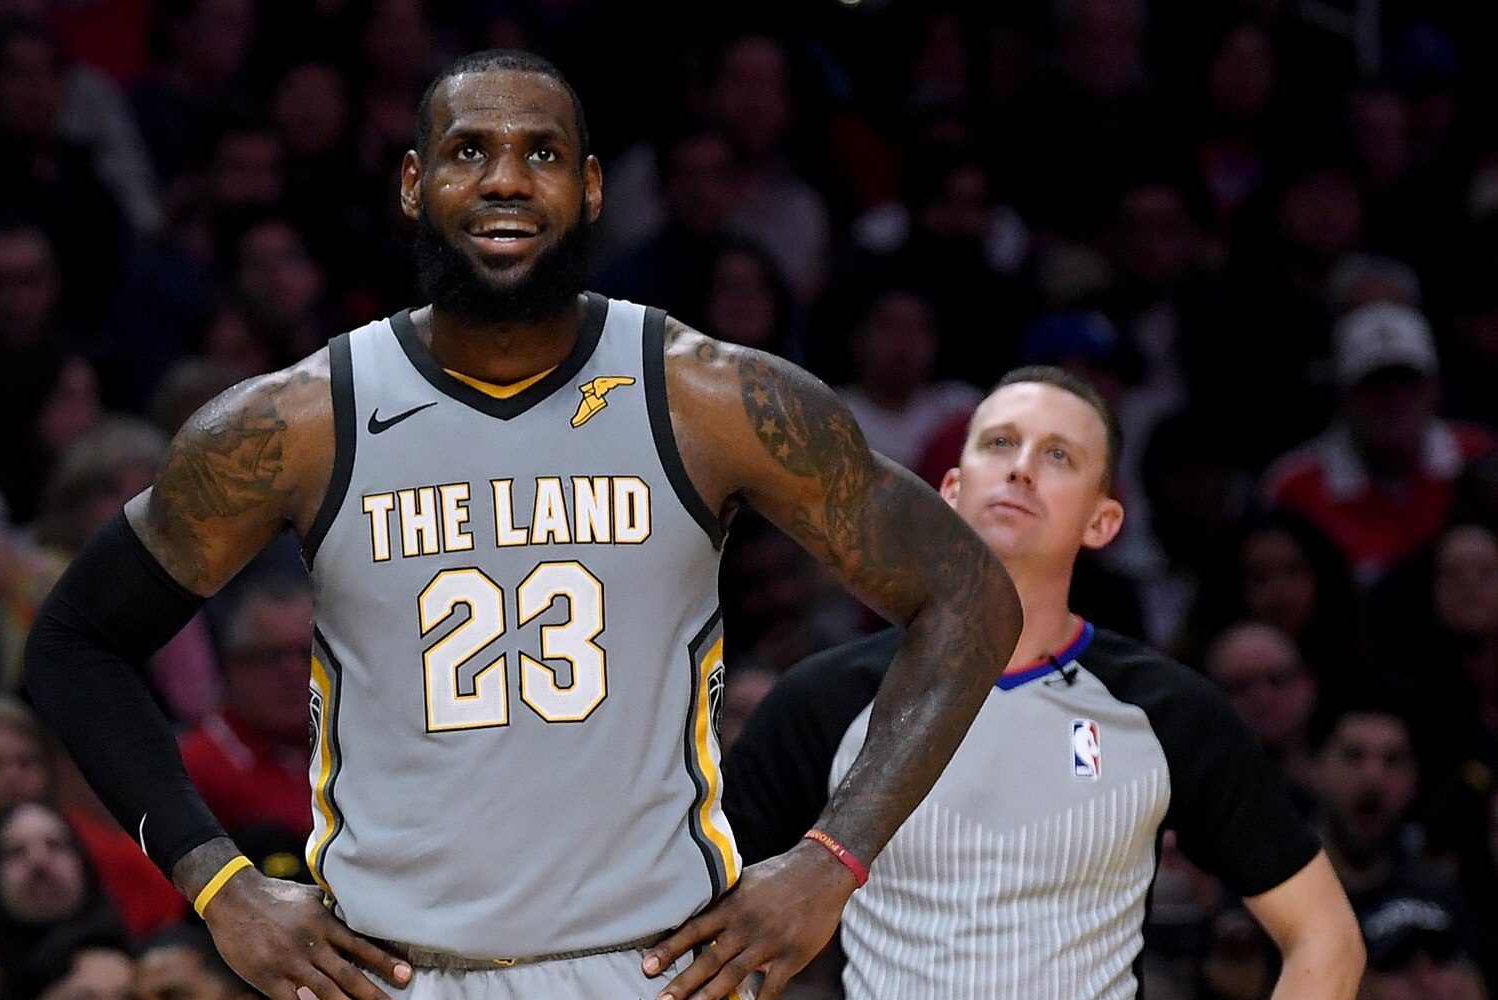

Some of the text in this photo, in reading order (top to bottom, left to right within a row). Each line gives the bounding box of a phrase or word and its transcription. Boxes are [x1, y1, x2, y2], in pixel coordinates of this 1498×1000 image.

[362, 475, 651, 562] THE LAND
[417, 560, 608, 734] 23
